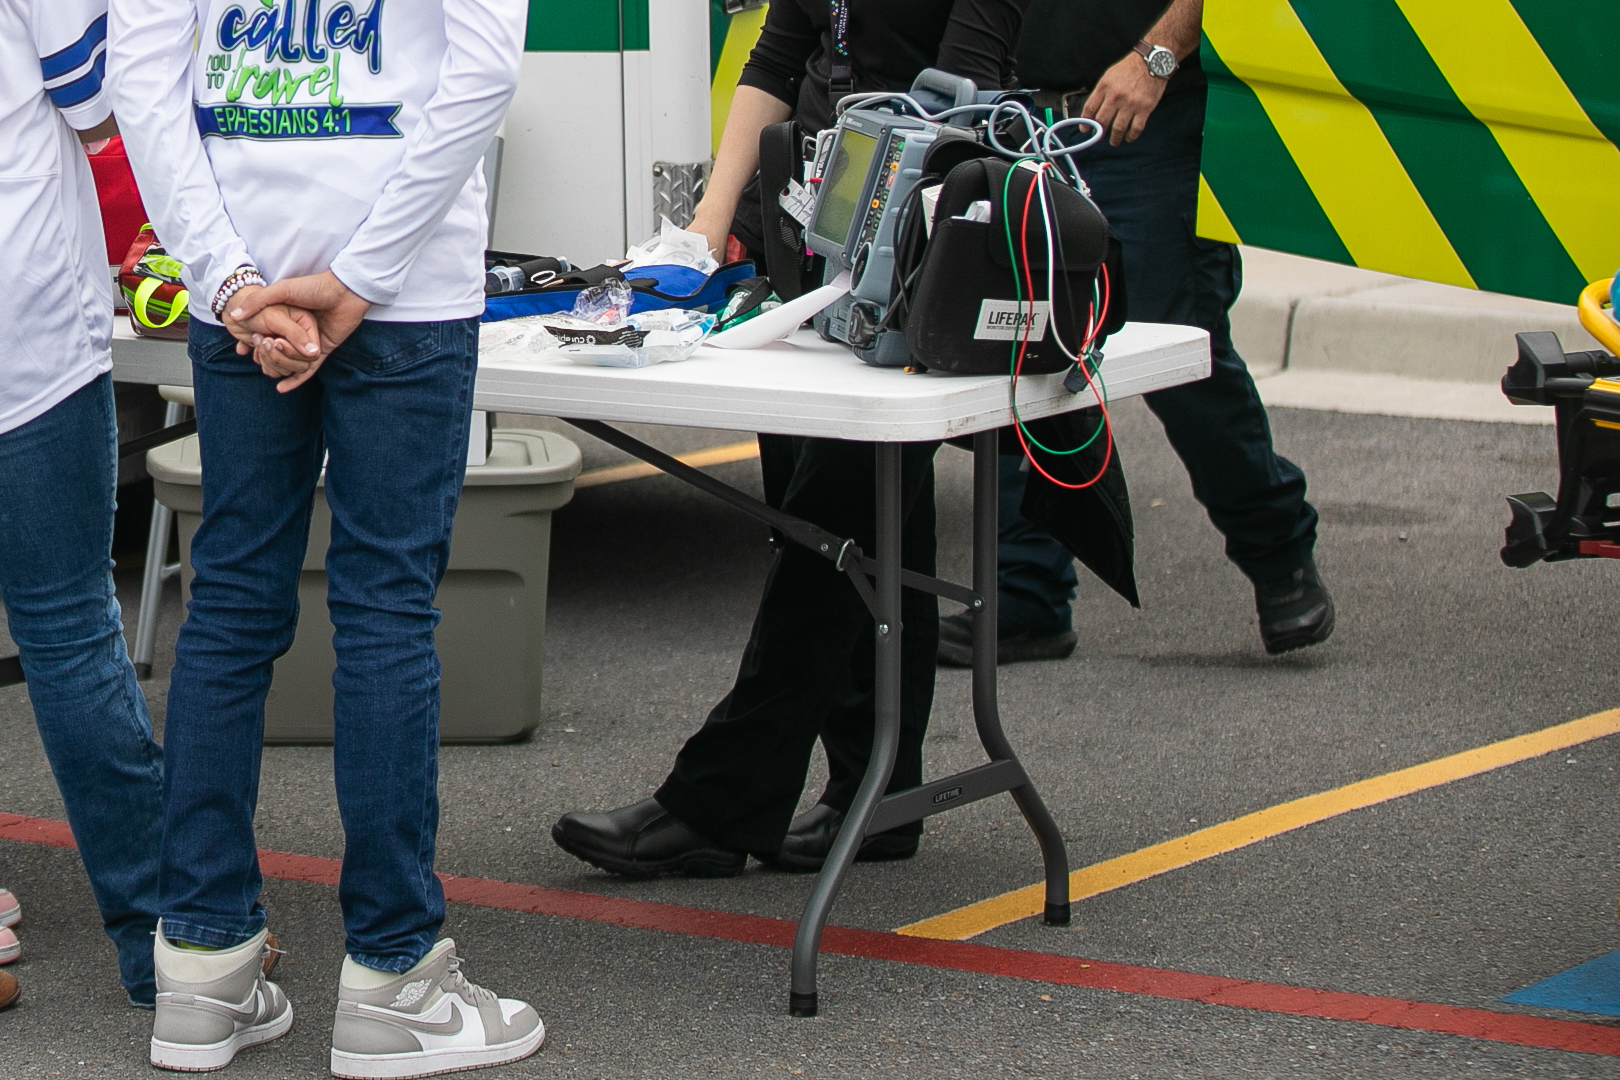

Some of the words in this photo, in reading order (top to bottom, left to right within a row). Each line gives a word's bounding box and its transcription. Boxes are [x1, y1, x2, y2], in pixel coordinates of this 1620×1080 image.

[206, 72, 225, 89] TO
[226, 50, 344, 108] travel
[214, 106, 318, 135] EPHESIANS
[322, 111, 351, 134] 4:1
[988, 311, 1037, 325] LIFEPAK
